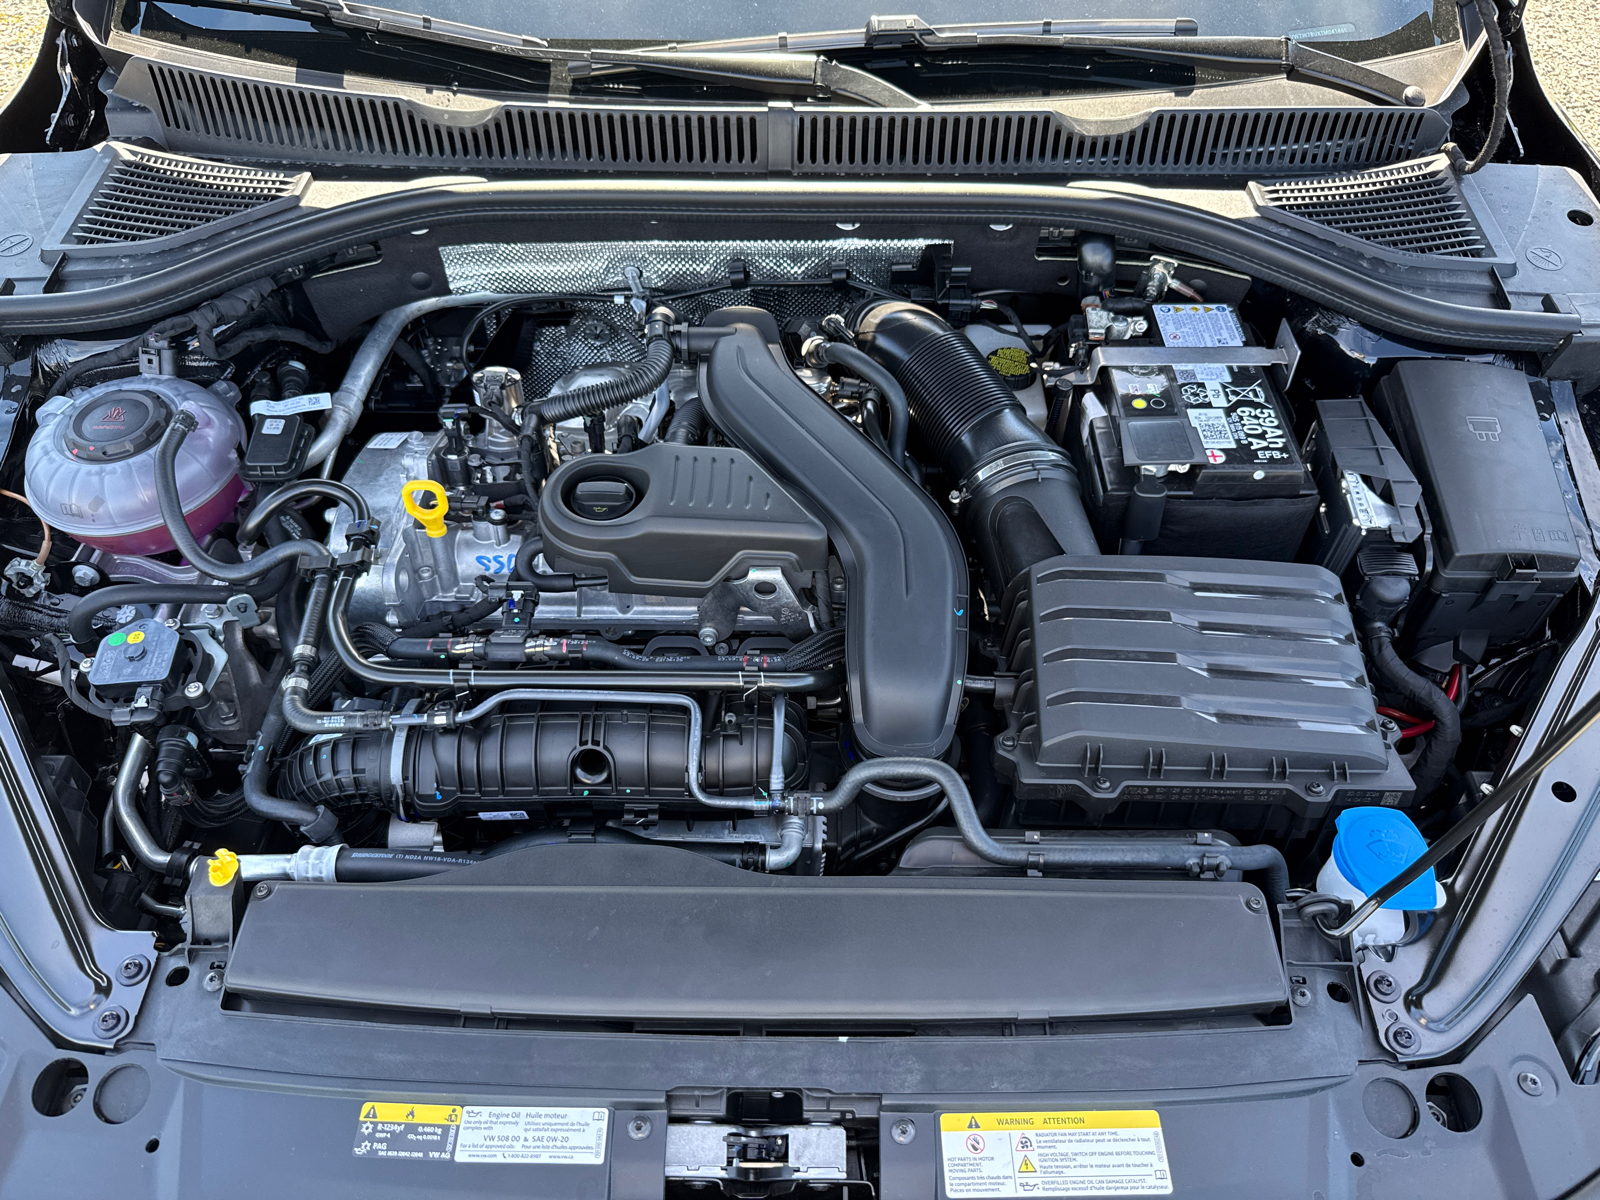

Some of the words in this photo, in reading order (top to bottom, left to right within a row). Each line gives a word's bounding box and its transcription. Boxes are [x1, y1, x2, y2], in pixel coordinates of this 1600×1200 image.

[1210, 389, 1221, 398] Pb
[1236, 406, 1263, 434] 640
[1255, 408, 1286, 448] 59Ah
[1248, 437, 1268, 450] A
[1258, 450, 1289, 460] EFB+
[488, 1112, 510, 1120] Engine
